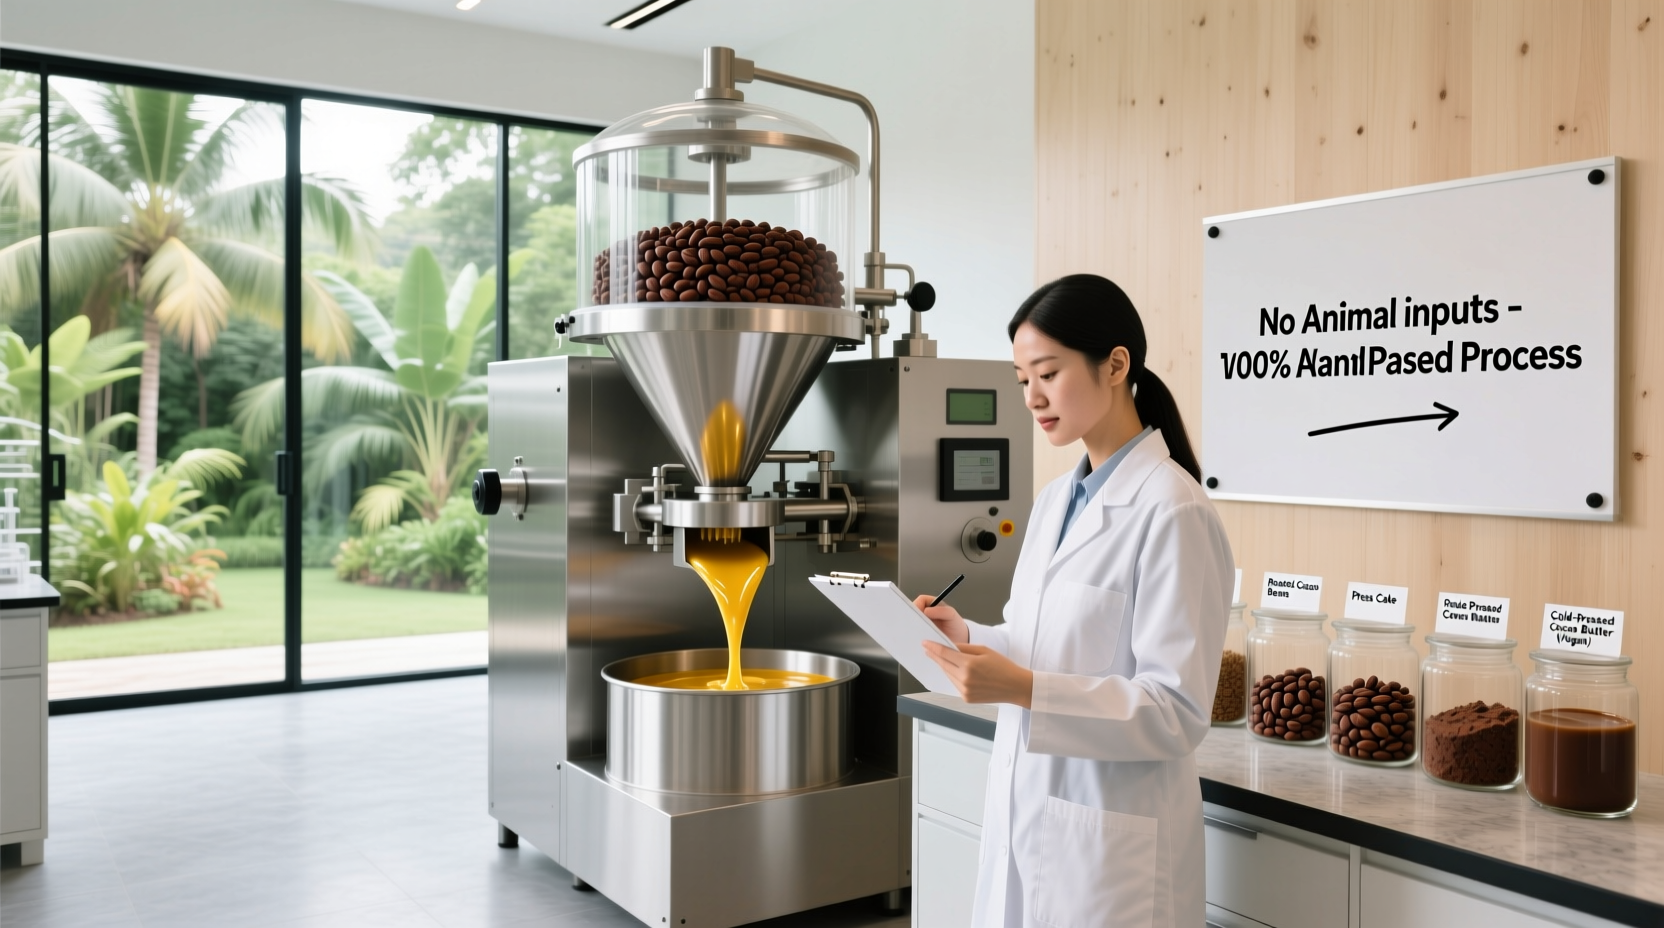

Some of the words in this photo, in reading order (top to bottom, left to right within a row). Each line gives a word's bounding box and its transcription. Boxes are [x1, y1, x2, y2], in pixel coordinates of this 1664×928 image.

[1259, 307, 1296, 336] No
[1302, 297, 1397, 334] Animal
[1404, 294, 1499, 335] inputs
[1461, 341, 1583, 372] Process
